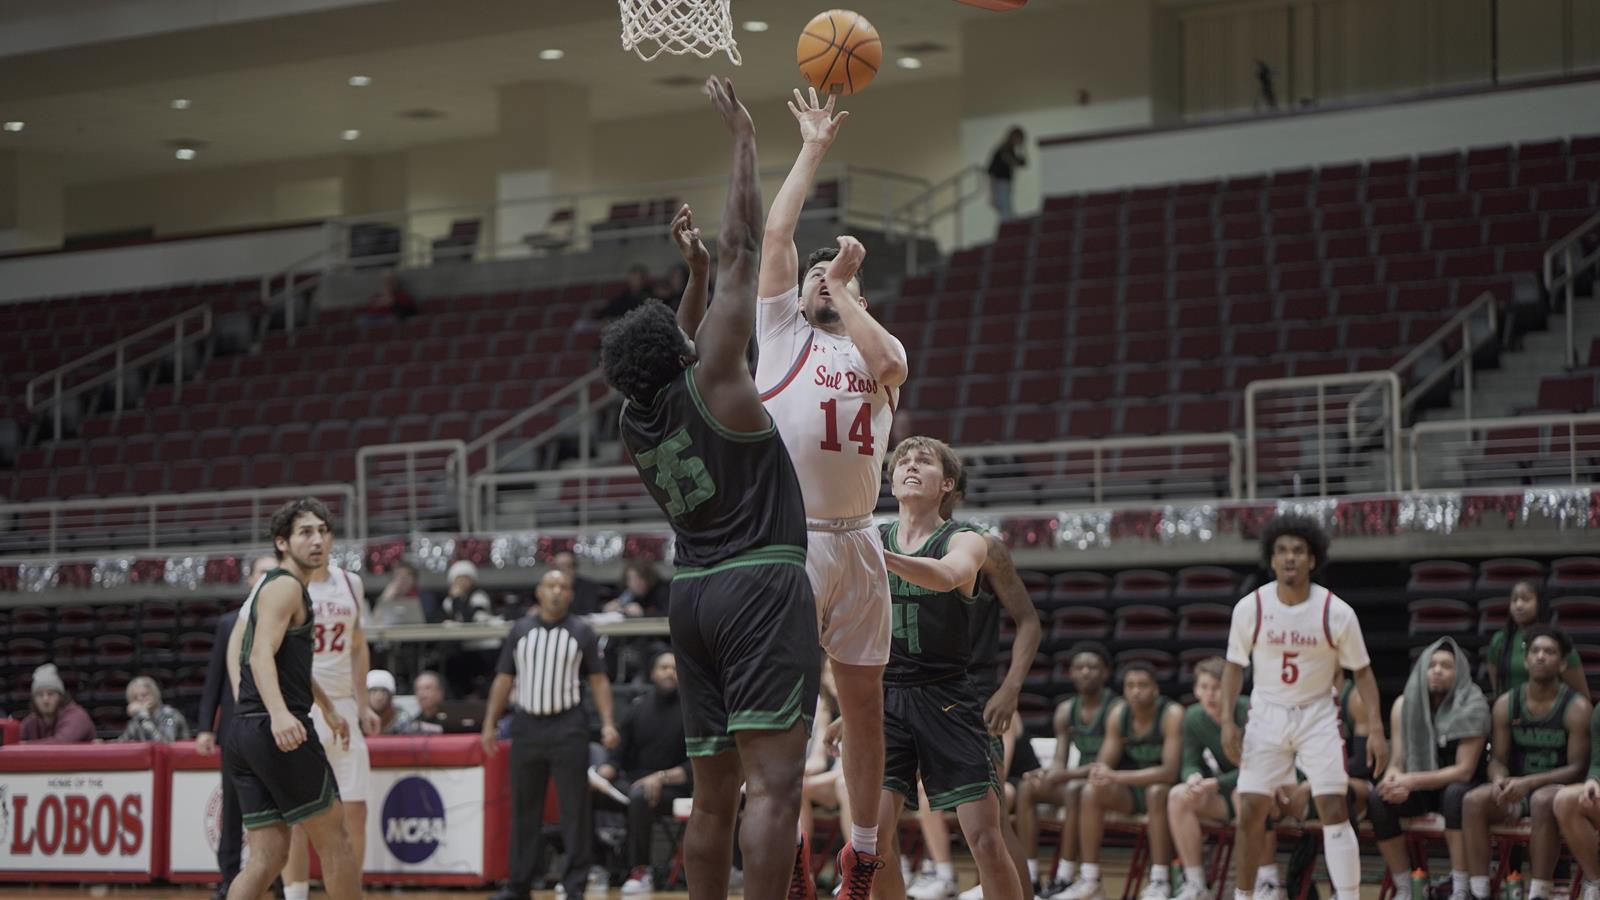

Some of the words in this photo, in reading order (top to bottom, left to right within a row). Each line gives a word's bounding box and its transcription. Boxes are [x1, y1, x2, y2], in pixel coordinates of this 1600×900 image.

[814, 364, 842, 390] Sul
[845, 371, 878, 394] Ross
[819, 397, 875, 457] 14
[312, 622, 346, 653] 32
[1266, 629, 1287, 646] Sul
[1291, 630, 1318, 647] Ross
[1280, 651, 1300, 685] 5
[10, 793, 144, 857] LOBOS
[385, 816, 447, 844] NCAA
